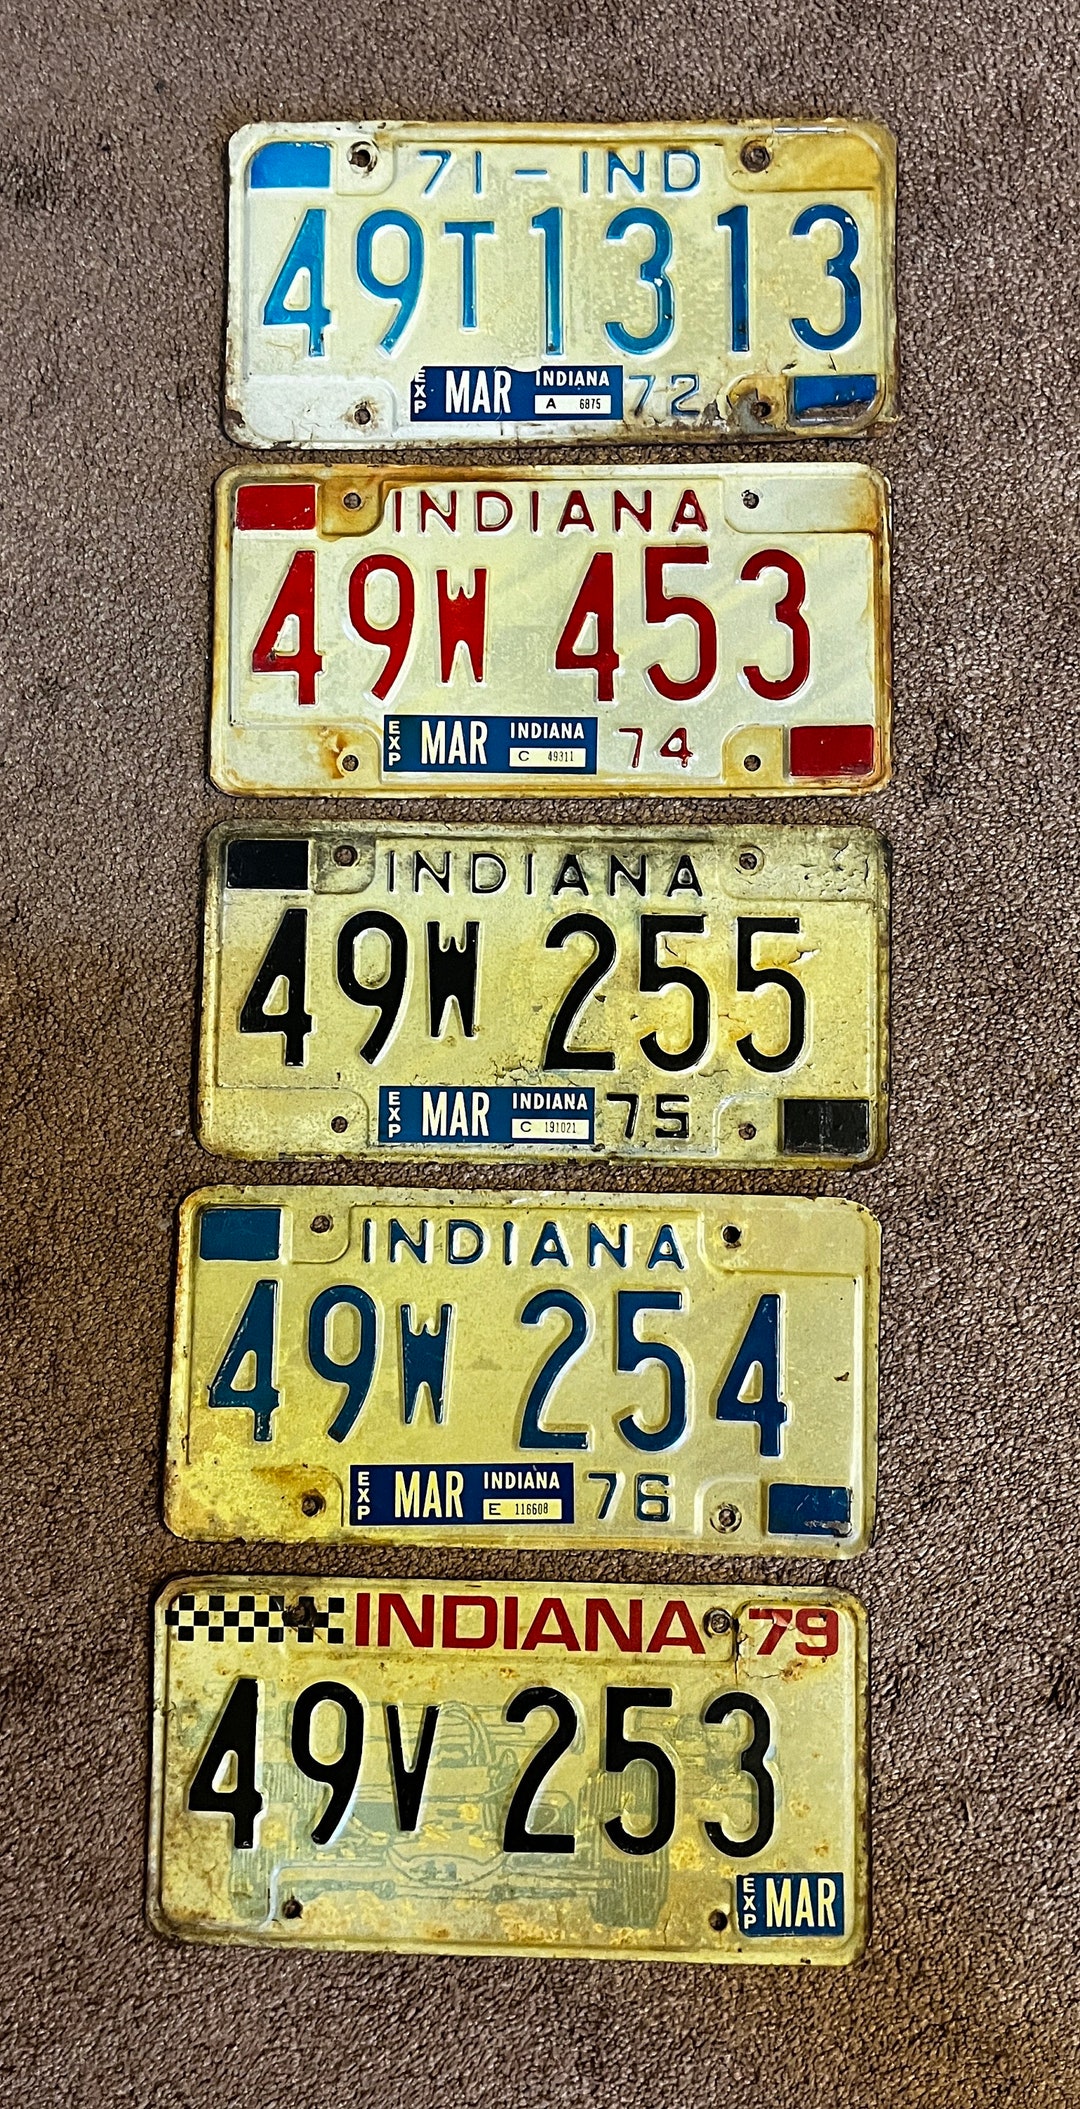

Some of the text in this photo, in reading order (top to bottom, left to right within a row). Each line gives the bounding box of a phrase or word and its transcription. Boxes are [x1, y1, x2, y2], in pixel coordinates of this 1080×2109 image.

[263, 204, 860, 357] 49T1313
[414, 369, 427, 413] EXP
[445, 370, 512, 414] MAR
[535, 370, 609, 387] INDIANA
[629, 374, 700, 417] 72
[546, 398, 601, 410] A 6875
[393, 489, 709, 533] INDIANA
[251, 546, 811, 706] 49W 453
[388, 721, 401, 766] EXP
[421, 720, 488, 765] MAR
[510, 722, 584, 739] INDIANA
[618, 727, 694, 768] 74
[518, 750, 575, 762] C 49311
[388, 851, 703, 895] INDIANA
[239, 908, 805, 1073] 49W 255
[388, 1091, 401, 1138] EXP
[422, 1091, 490, 1137] MAR
[512, 1092, 588, 1110] INDIANA
[606, 1091, 690, 1139] 75
[520, 1121, 577, 1134] C 191021
[363, 1218, 685, 1269] INDIANA
[208, 1280, 788, 1456] 49W 254
[357, 1471, 371, 1520] EXP
[394, 1470, 464, 1518] MAR
[483, 1471, 560, 1489] INDIANA
[587, 1472, 671, 1522] 76
[489, 1502, 549, 1515] E 116608
[354, 1592, 839, 1656] INDIANA 79
[188, 1677, 775, 1858] 49V 253
[743, 1877, 757, 1929] EXP
[766, 1877, 836, 1927] MAR
